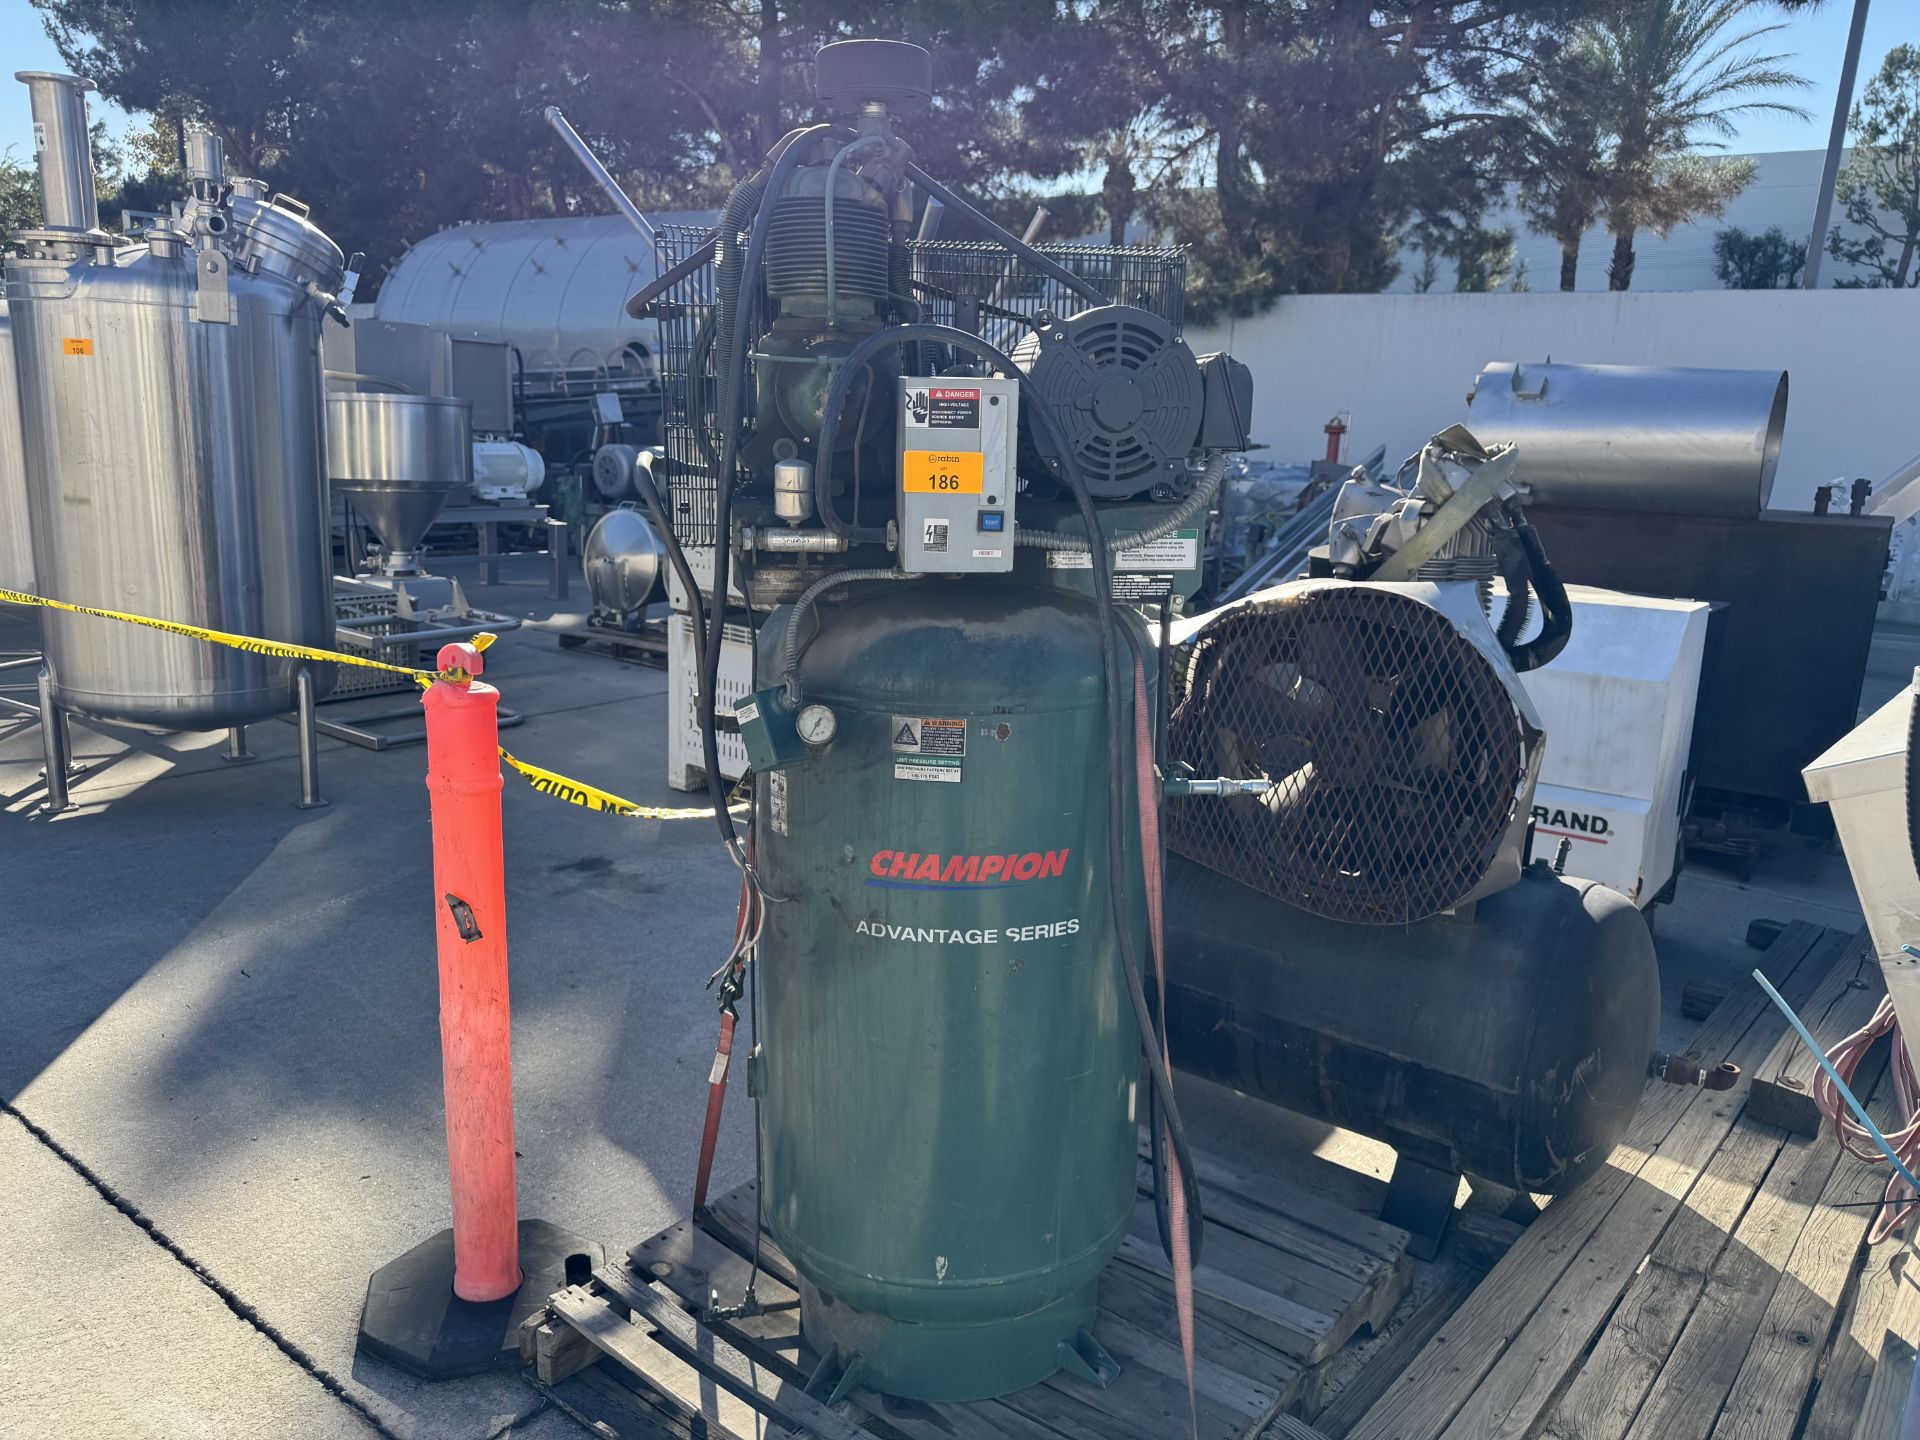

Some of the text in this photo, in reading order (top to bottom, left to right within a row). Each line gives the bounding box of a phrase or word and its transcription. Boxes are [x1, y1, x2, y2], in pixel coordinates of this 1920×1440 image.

[929, 474, 960, 490] 186
[1532, 804, 1609, 835] RAND
[869, 848, 1070, 882] CHAMPION
[855, 918, 1080, 945] ADVANTAGE SERIES
